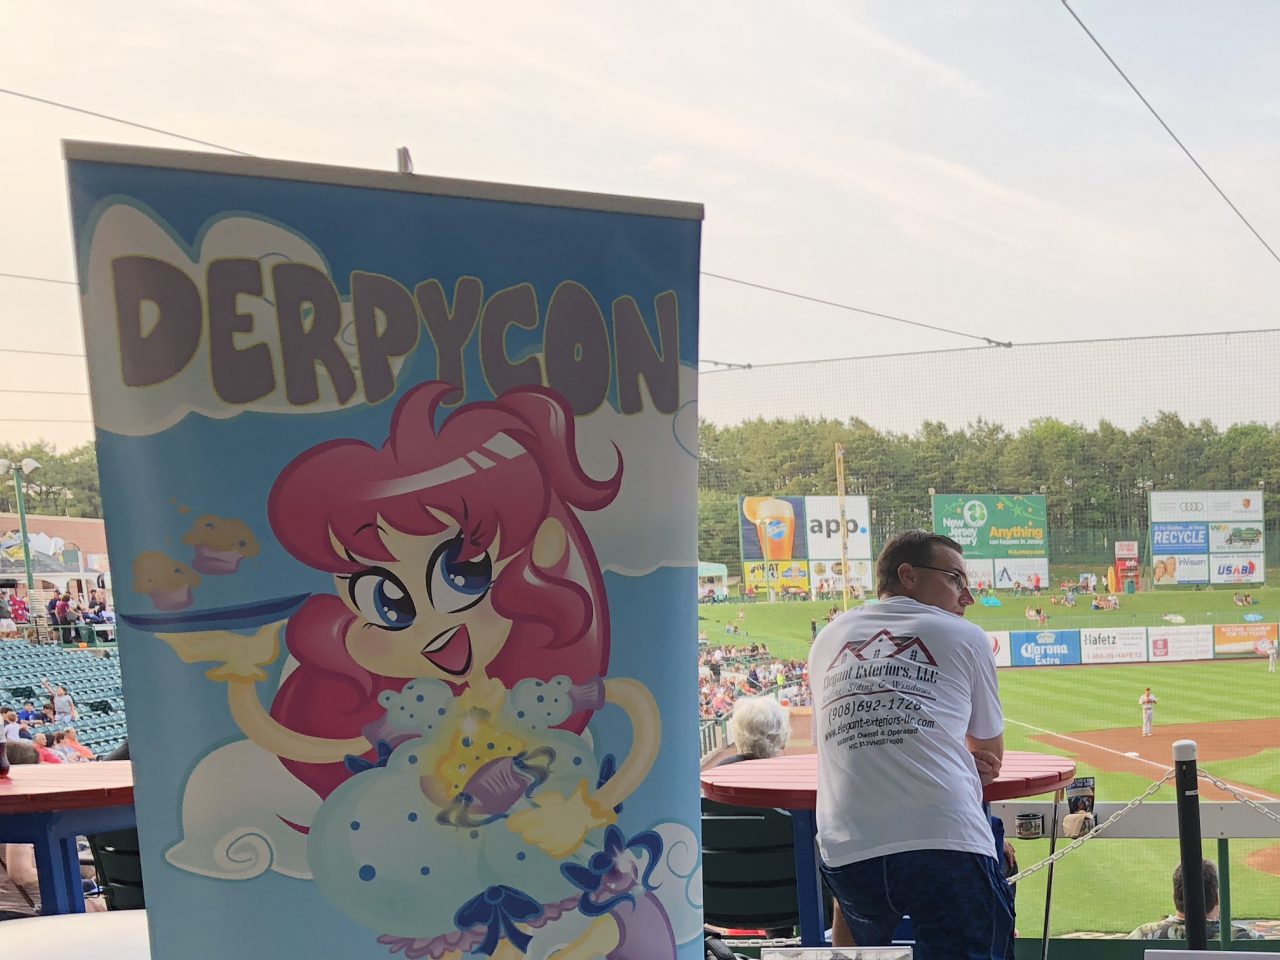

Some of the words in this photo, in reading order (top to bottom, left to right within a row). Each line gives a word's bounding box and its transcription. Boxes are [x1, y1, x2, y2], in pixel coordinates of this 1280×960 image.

[110, 254, 680, 418] DERPYCON
[943, 517, 965, 528] New
[948, 526, 978, 537] Jersey
[989, 526, 1043, 539] Anything
[1154, 530, 1206, 544] RECYCLE
[1083, 633, 1117, 646] Hafetz
[1020, 642, 1069, 659] Corona
[1034, 655, 1060, 665] Extra
[855, 661, 912, 680] Exteriors,
[916, 665, 939, 684] LLC
